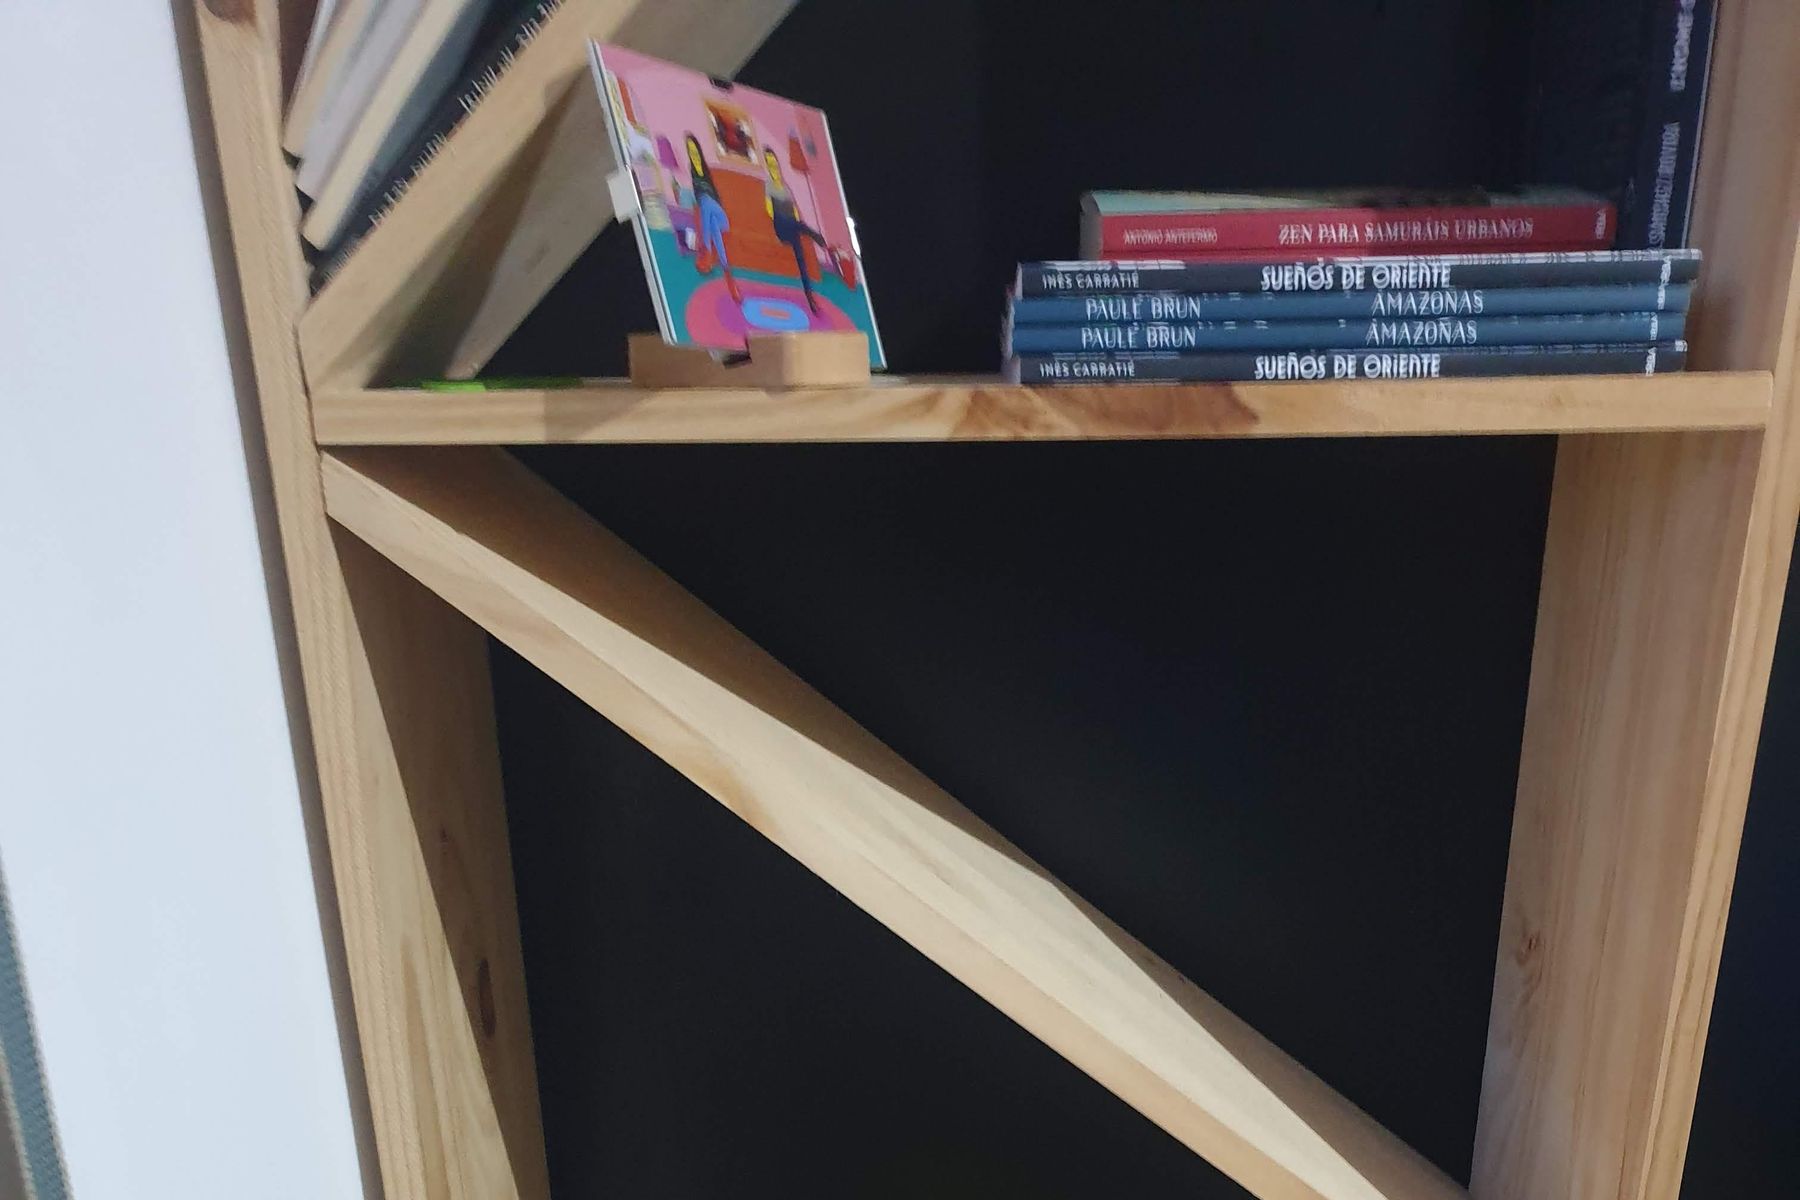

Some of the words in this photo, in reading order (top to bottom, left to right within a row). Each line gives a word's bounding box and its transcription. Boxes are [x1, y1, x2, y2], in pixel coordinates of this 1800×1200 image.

[1279, 224, 1312, 245] ZEN
[1318, 223, 1359, 243] PARA
[1454, 217, 1534, 240] URBANOS
[1260, 263, 1334, 291] SUEÑOS
[1341, 264, 1365, 290] DE
[1371, 262, 1451, 290] ORIENTE
[1150, 296, 1200, 320] BRUN
[1371, 291, 1483, 315] AMAZONAS
[1147, 325, 1196, 348] BRUN
[1366, 321, 1477, 345] AMAZONAS
[1254, 352, 1326, 380] SUEÑOS
[1333, 355, 1356, 379] DE
[1363, 353, 1441, 379] ORIENTE
